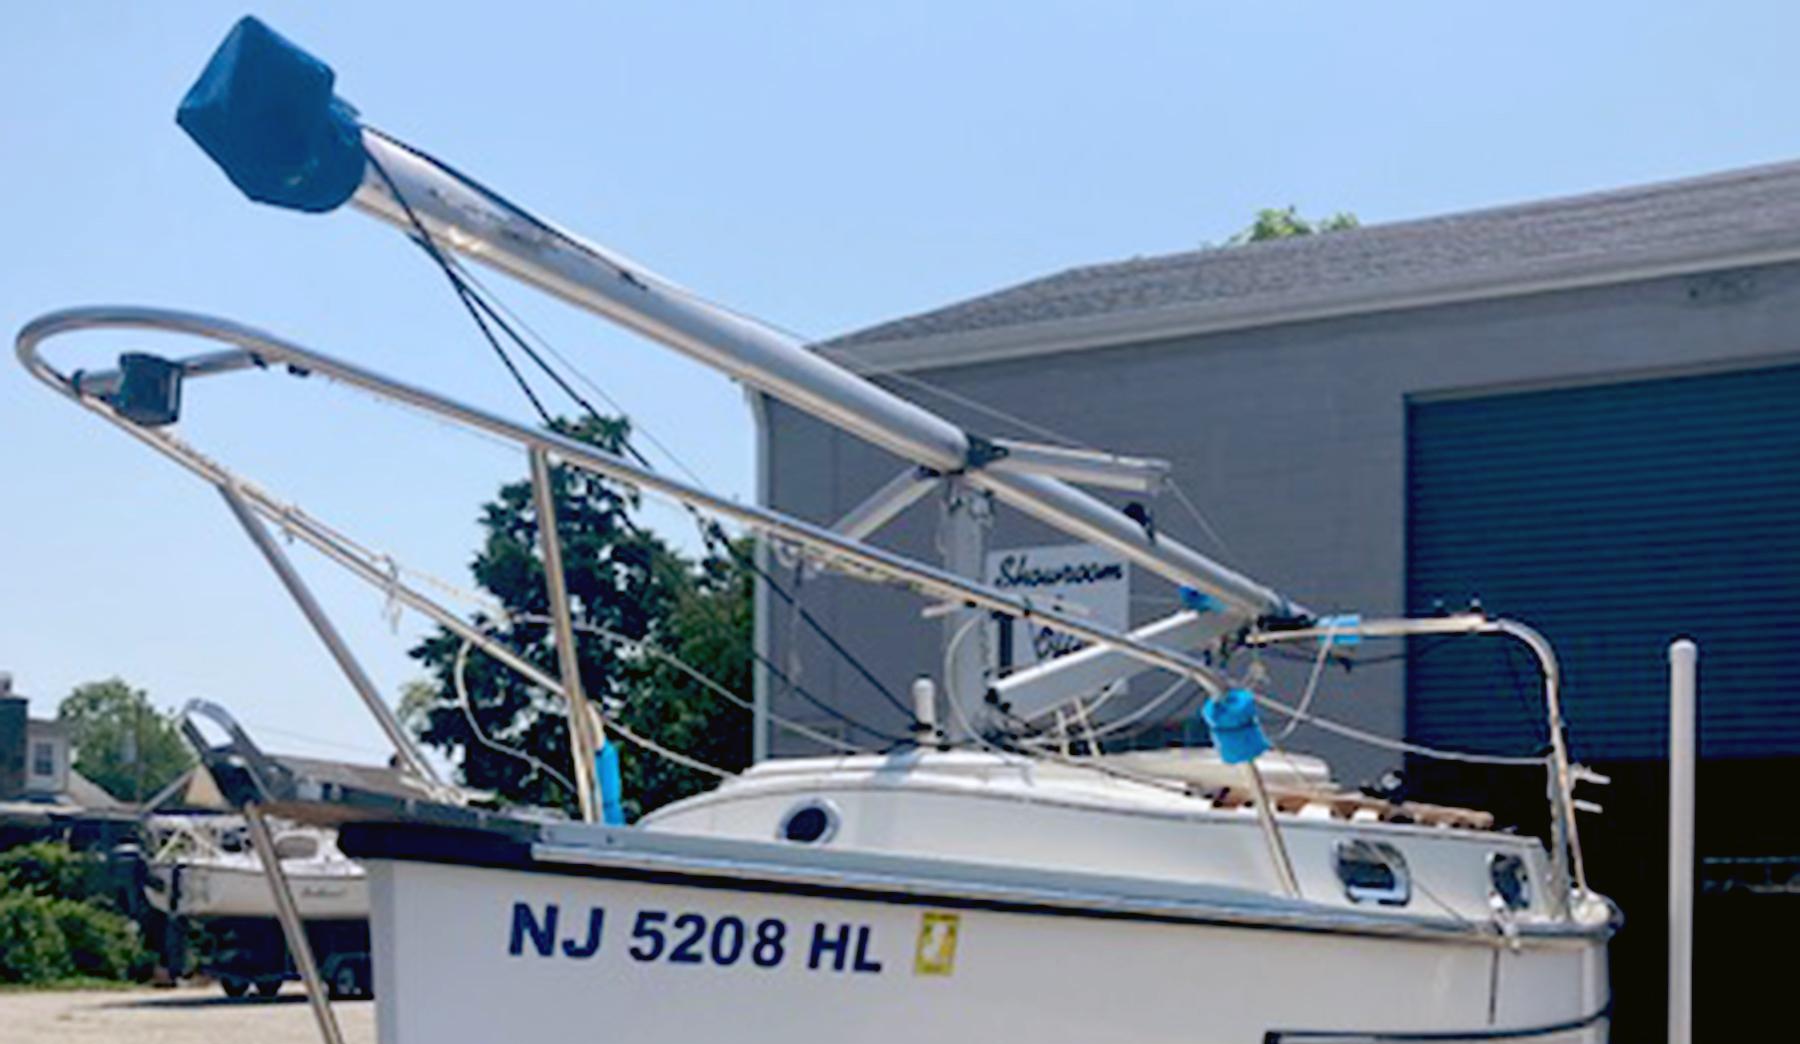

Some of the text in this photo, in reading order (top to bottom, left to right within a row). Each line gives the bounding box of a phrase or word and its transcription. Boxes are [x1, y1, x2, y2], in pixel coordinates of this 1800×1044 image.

[994, 554, 1123, 589] Showroom
[508, 902, 604, 958] NJ
[628, 910, 787, 968] 5208
[808, 922, 883, 974] HL
